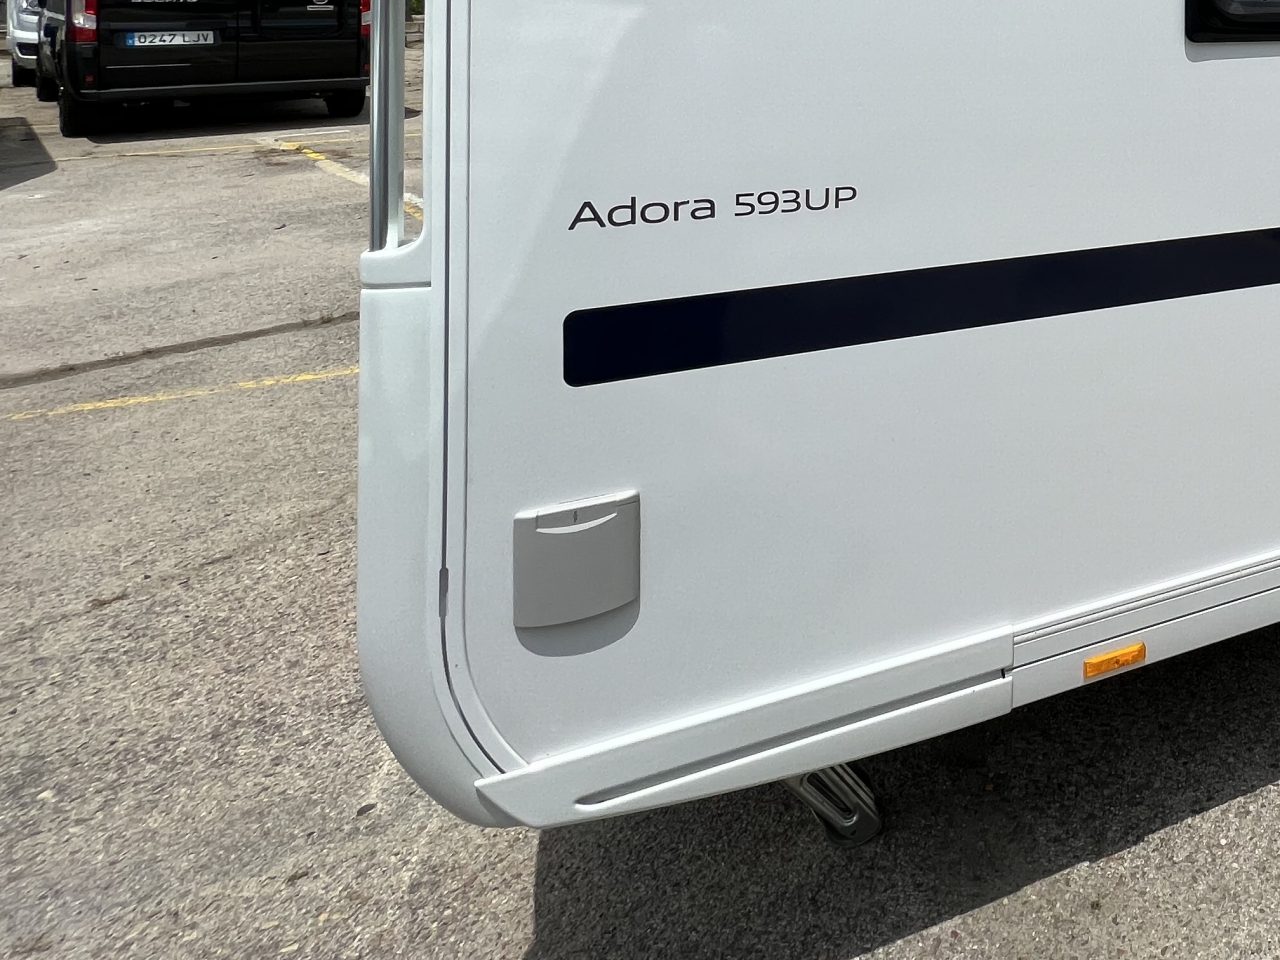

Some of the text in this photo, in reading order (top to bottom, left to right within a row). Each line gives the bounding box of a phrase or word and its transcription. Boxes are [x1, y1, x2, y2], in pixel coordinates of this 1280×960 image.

[138, 32, 209, 44] 0247 LJV
[568, 186, 858, 230] Adora 593UP
